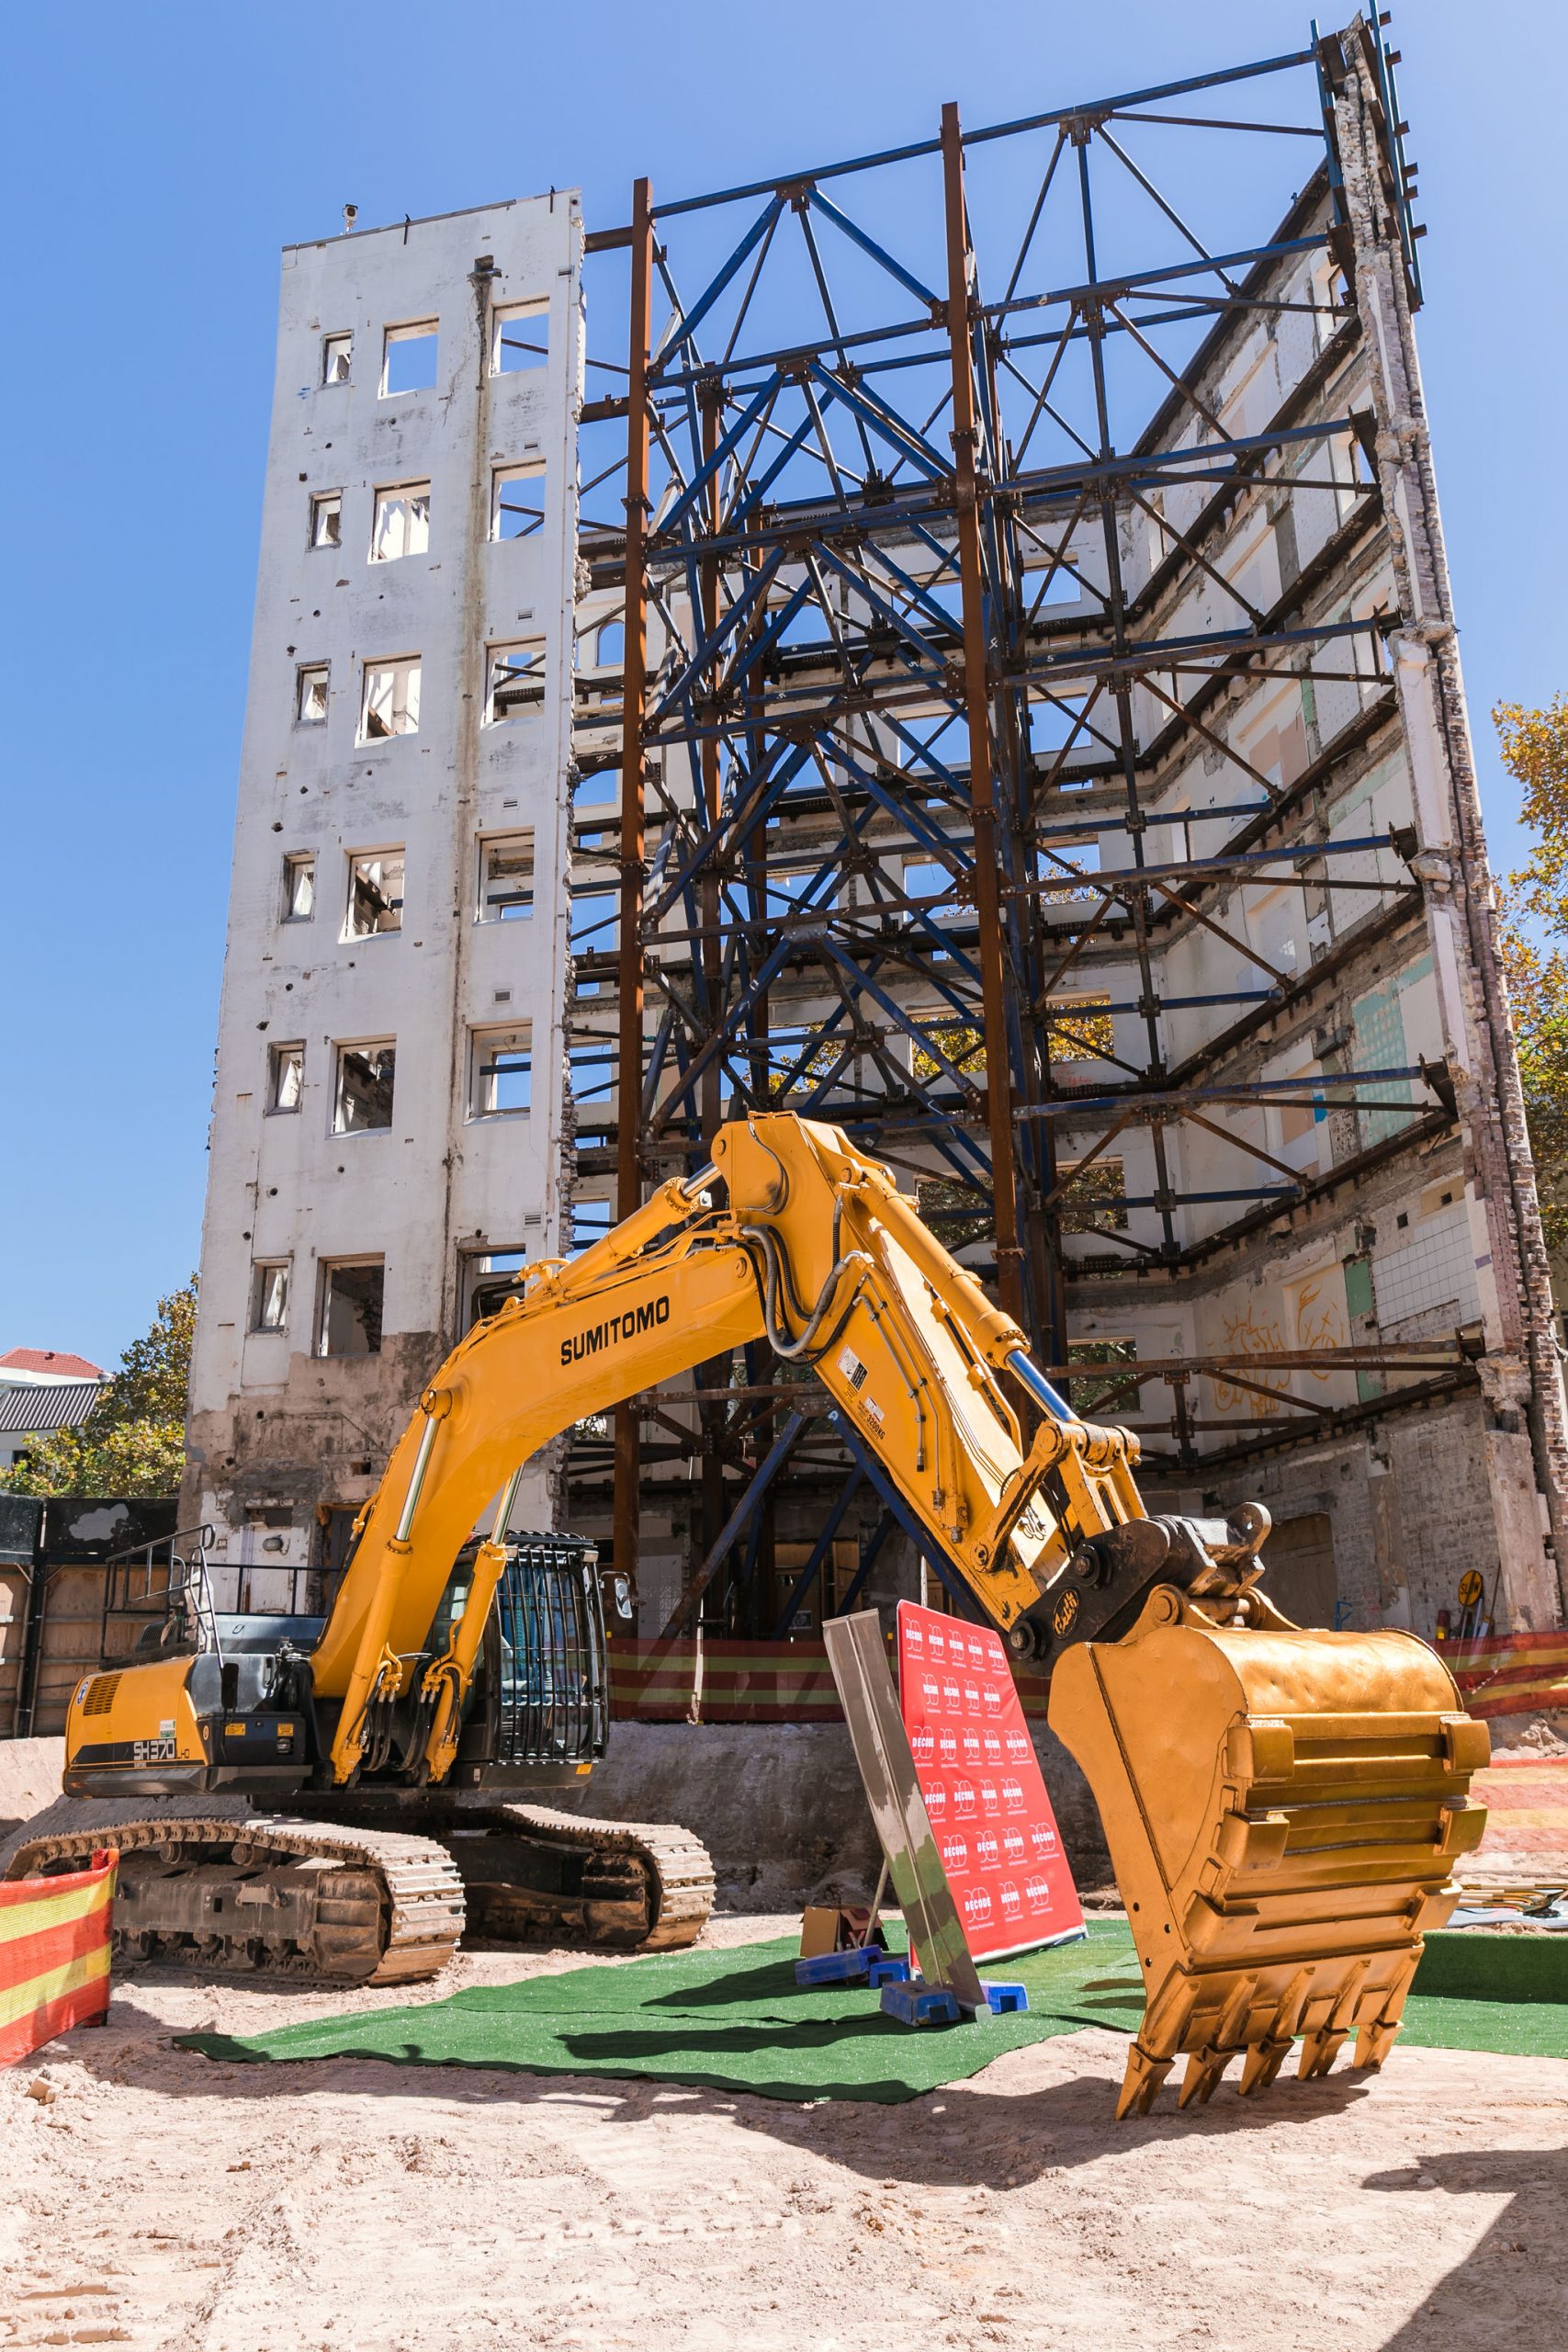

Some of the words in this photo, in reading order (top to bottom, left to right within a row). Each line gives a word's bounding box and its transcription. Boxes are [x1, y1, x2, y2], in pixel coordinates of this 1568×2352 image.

[1046, 654, 1055, 662] 5
[561, 1295, 670, 1366] SUMITOMO
[866, 1415, 886, 1440] 3200KG
[1461, 1581, 1481, 1595] SLW
[912, 1737, 934, 1747] DECODE
[940, 1739, 956, 1749] DECODE
[964, 1738, 979, 1747] DECODE
[984, 1739, 1000, 1748] DECODE
[1006, 1738, 1028, 1748] DECODE
[133, 1738, 175, 1761] SH370
[925, 1792, 945, 1804] DECODE
[953, 1791, 975, 1802] DECODE
[981, 1789, 997, 1799] DECODE
[1002, 1787, 1023, 1798] DECODE
[1004, 1837, 1023, 1849] DECODE
[1032, 1831, 1055, 1844] DECODE
[943, 1844, 967, 1858] DECODE
[976, 1840, 998, 1852] DECODE
[1026, 1883, 1049, 1897] DECODE
[1001, 1891, 1020, 1904] DECODE
[964, 1896, 992, 1912] DECODE
